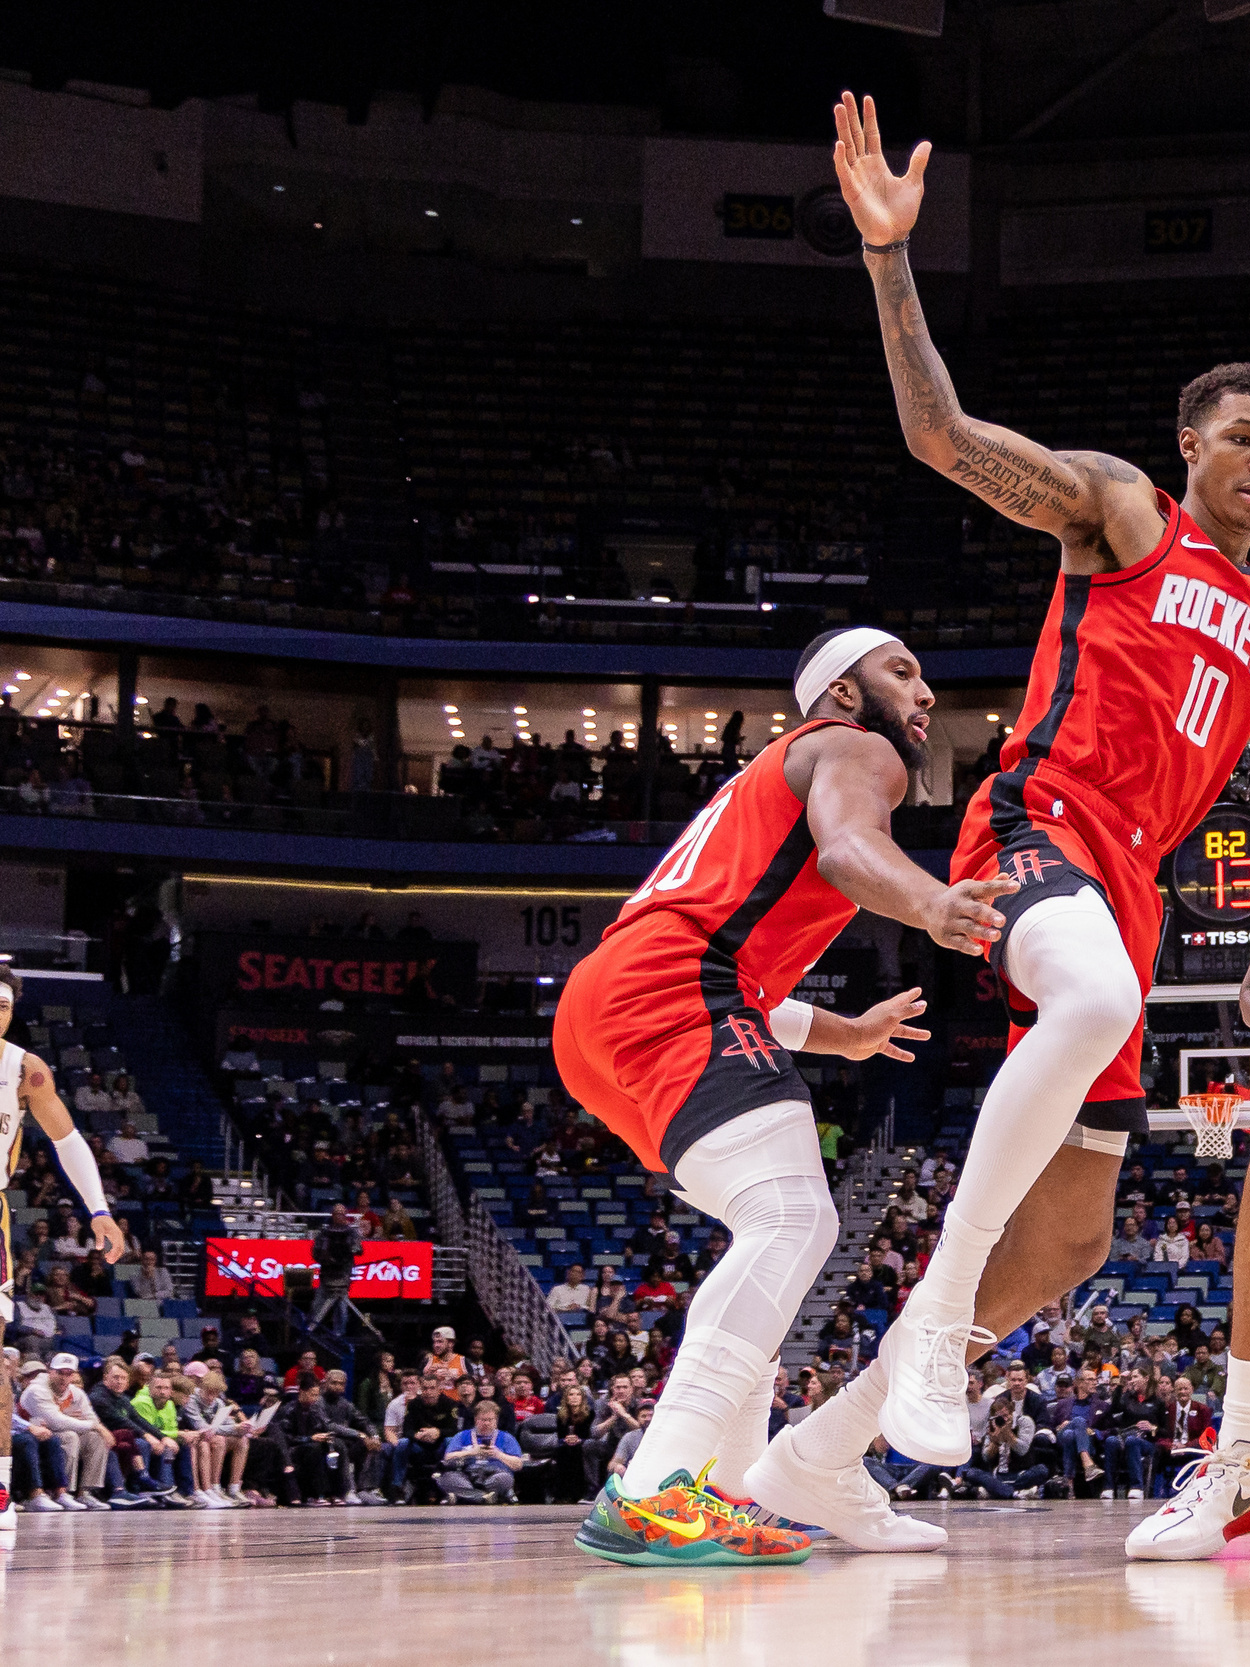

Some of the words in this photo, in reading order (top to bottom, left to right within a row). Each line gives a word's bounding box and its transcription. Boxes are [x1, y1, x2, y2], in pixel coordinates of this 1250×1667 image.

[727, 201, 792, 232] 306
[1148, 218, 1206, 245] 307
[947, 423, 1026, 490] MEDIOCRITY
[1020, 482, 1050, 505] And
[949, 458, 1038, 519] POTENTIAL
[966, 425, 1040, 481] Complacency
[1037, 465, 1080, 500] Breeds
[1175, 653, 1230, 748] 10
[521, 906, 582, 947] 105
[237, 950, 438, 1000] SEATGEEK
